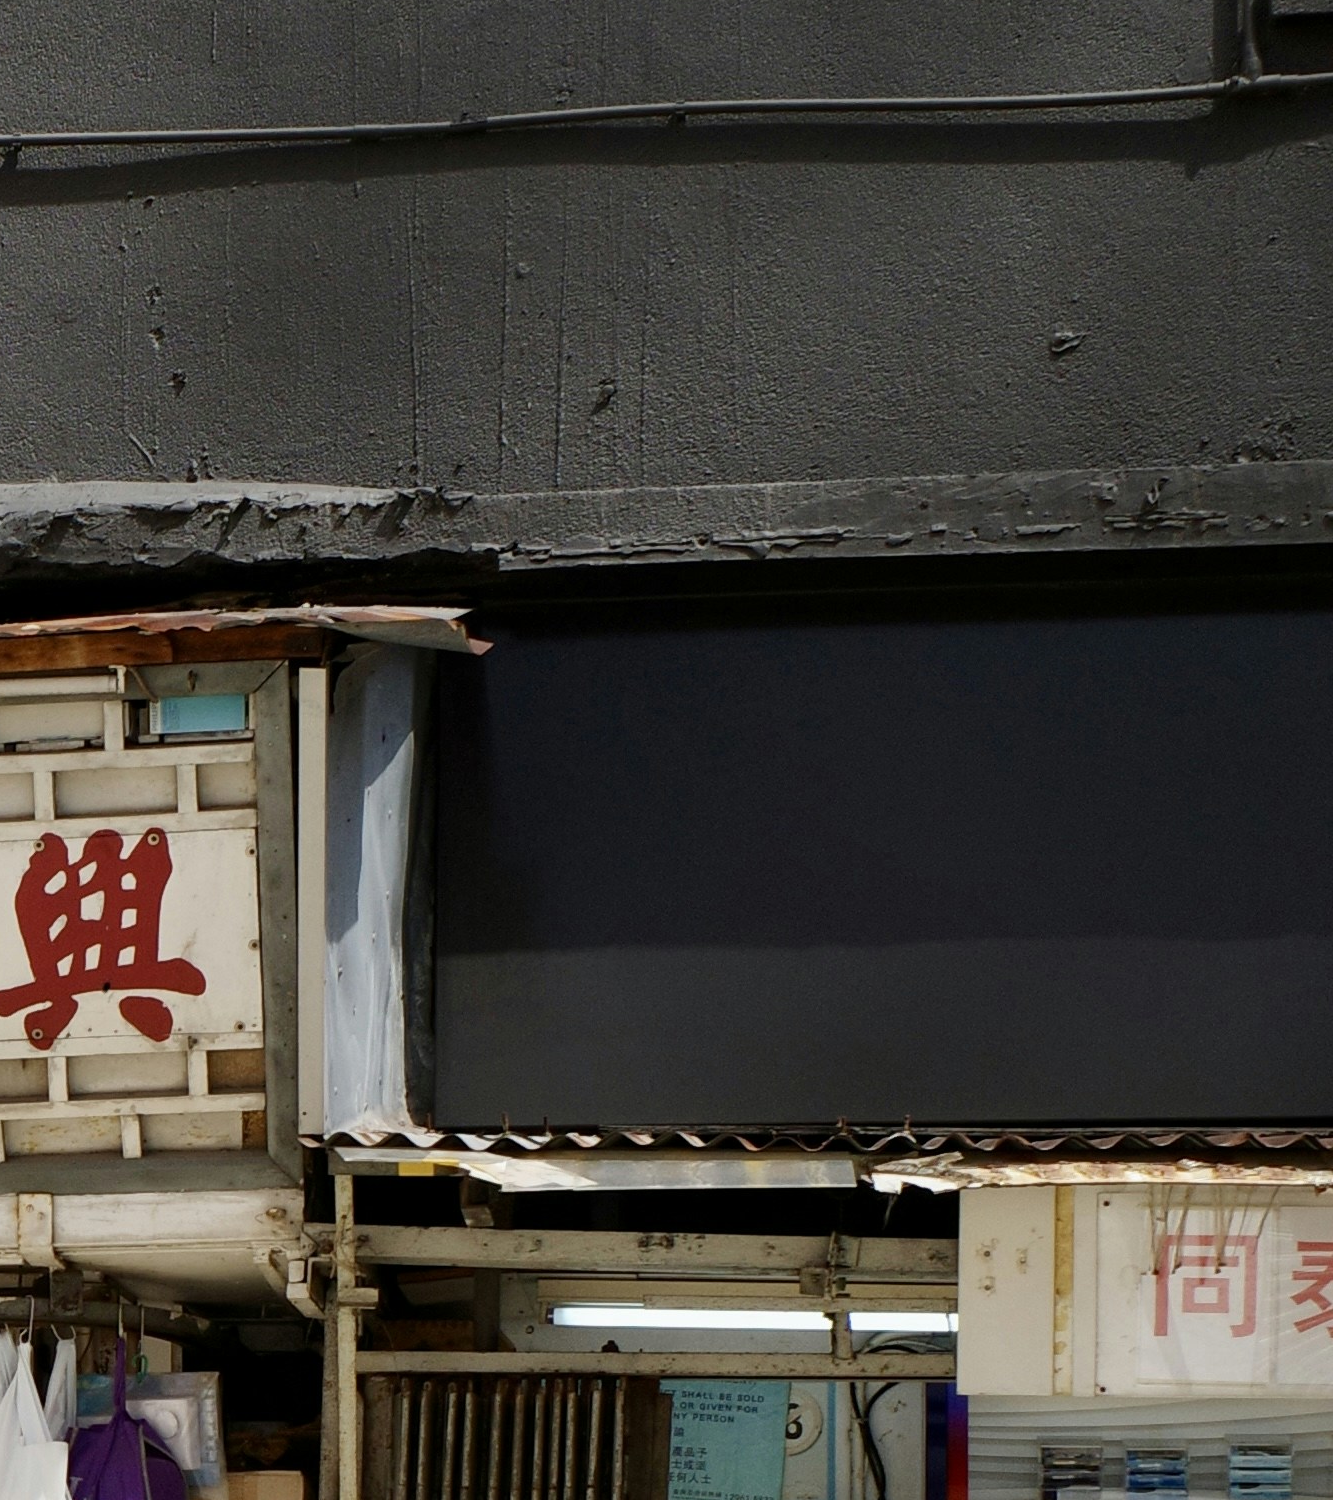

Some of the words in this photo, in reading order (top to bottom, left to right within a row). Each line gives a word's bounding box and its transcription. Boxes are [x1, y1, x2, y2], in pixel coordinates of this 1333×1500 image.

[682, 1391, 713, 1400] SHALL
[719, 1393, 732, 1401] BE
[738, 1394, 764, 1403] SOLD
[680, 1402, 694, 1410] OR
[700, 1403, 732, 1412] GIVEN
[736, 1405, 758, 1413] FOR
[693, 1413, 735, 1423] PERSON
